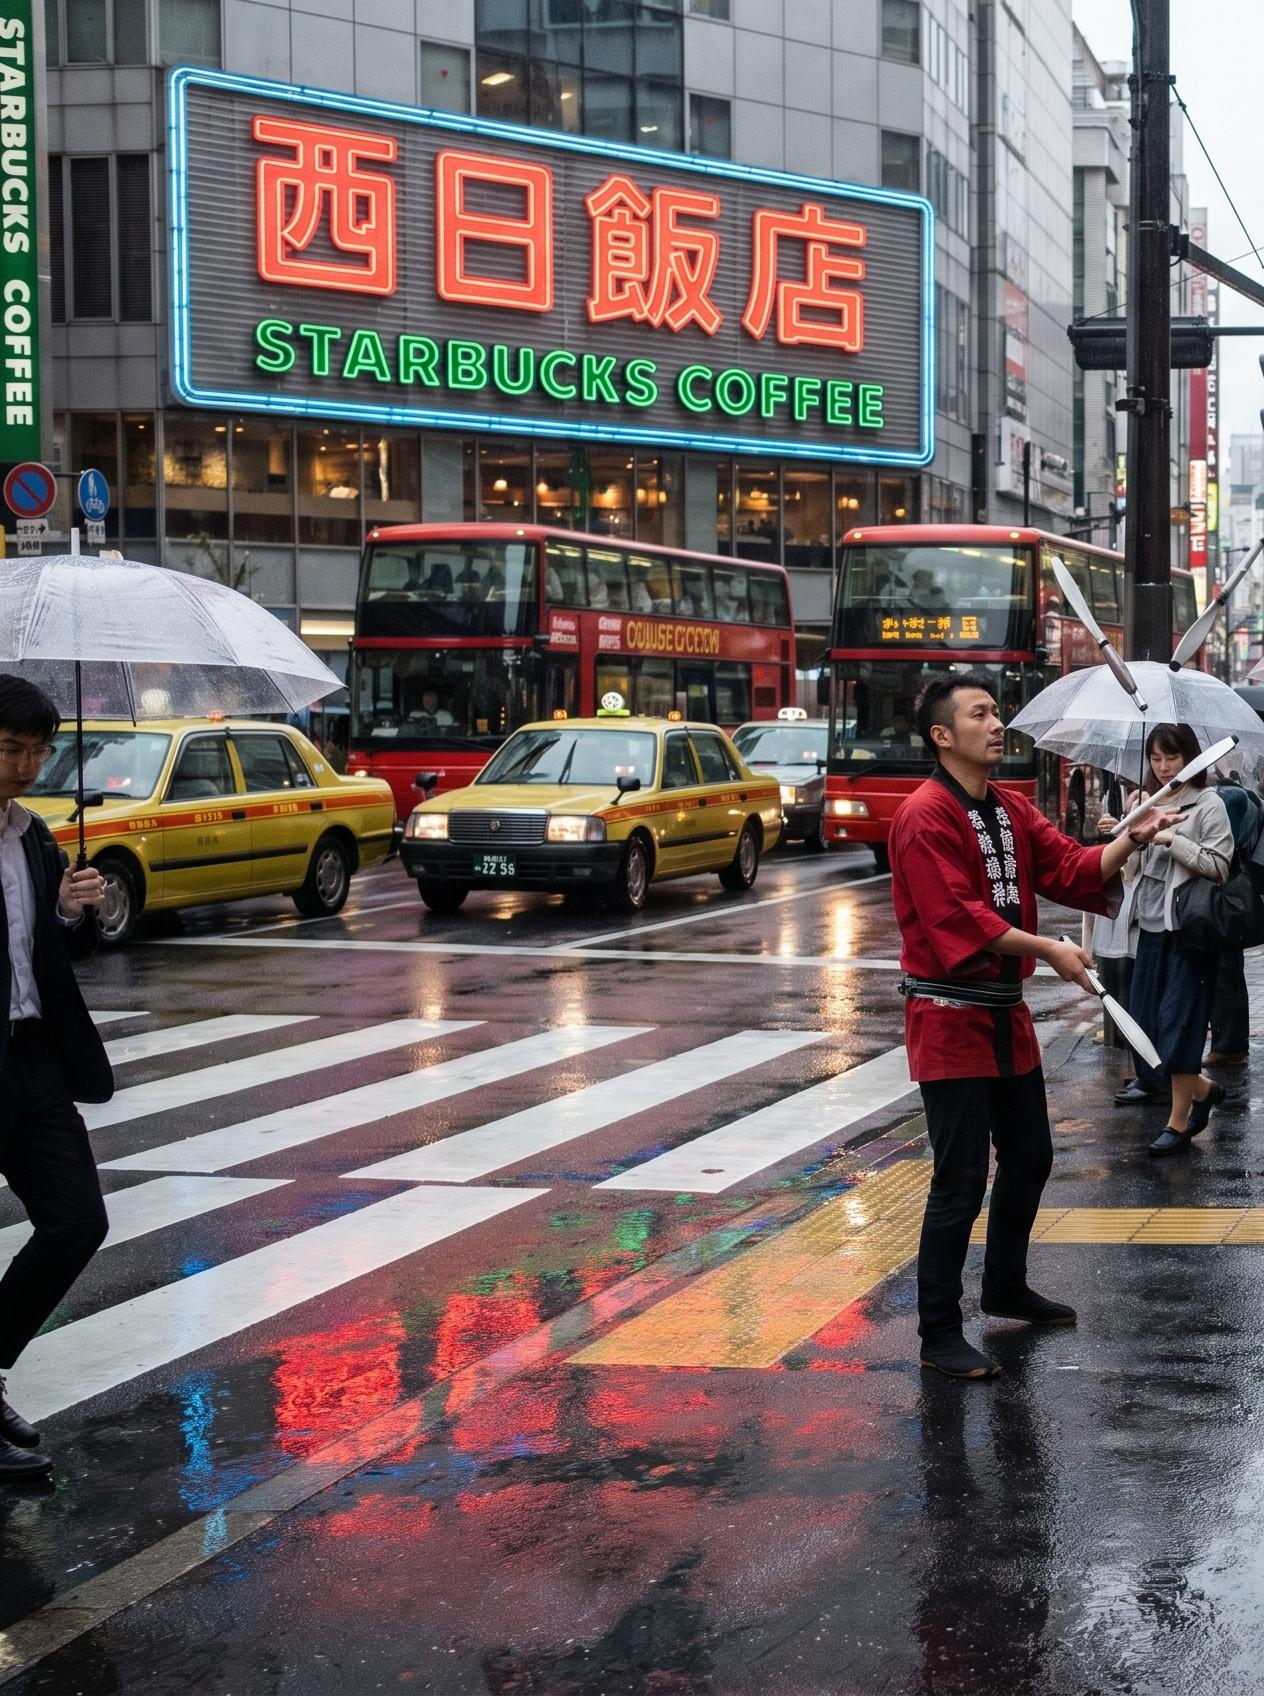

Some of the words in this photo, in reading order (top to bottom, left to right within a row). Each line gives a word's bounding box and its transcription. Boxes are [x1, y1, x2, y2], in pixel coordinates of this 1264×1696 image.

[0, 17, 30, 254] STARBUCKS
[251, 114, 868, 353] 西日飯店
[3, 279, 33, 426] COFFEE
[255, 318, 659, 407] STARBUCKS
[677, 365, 885, 429] COFFEE
